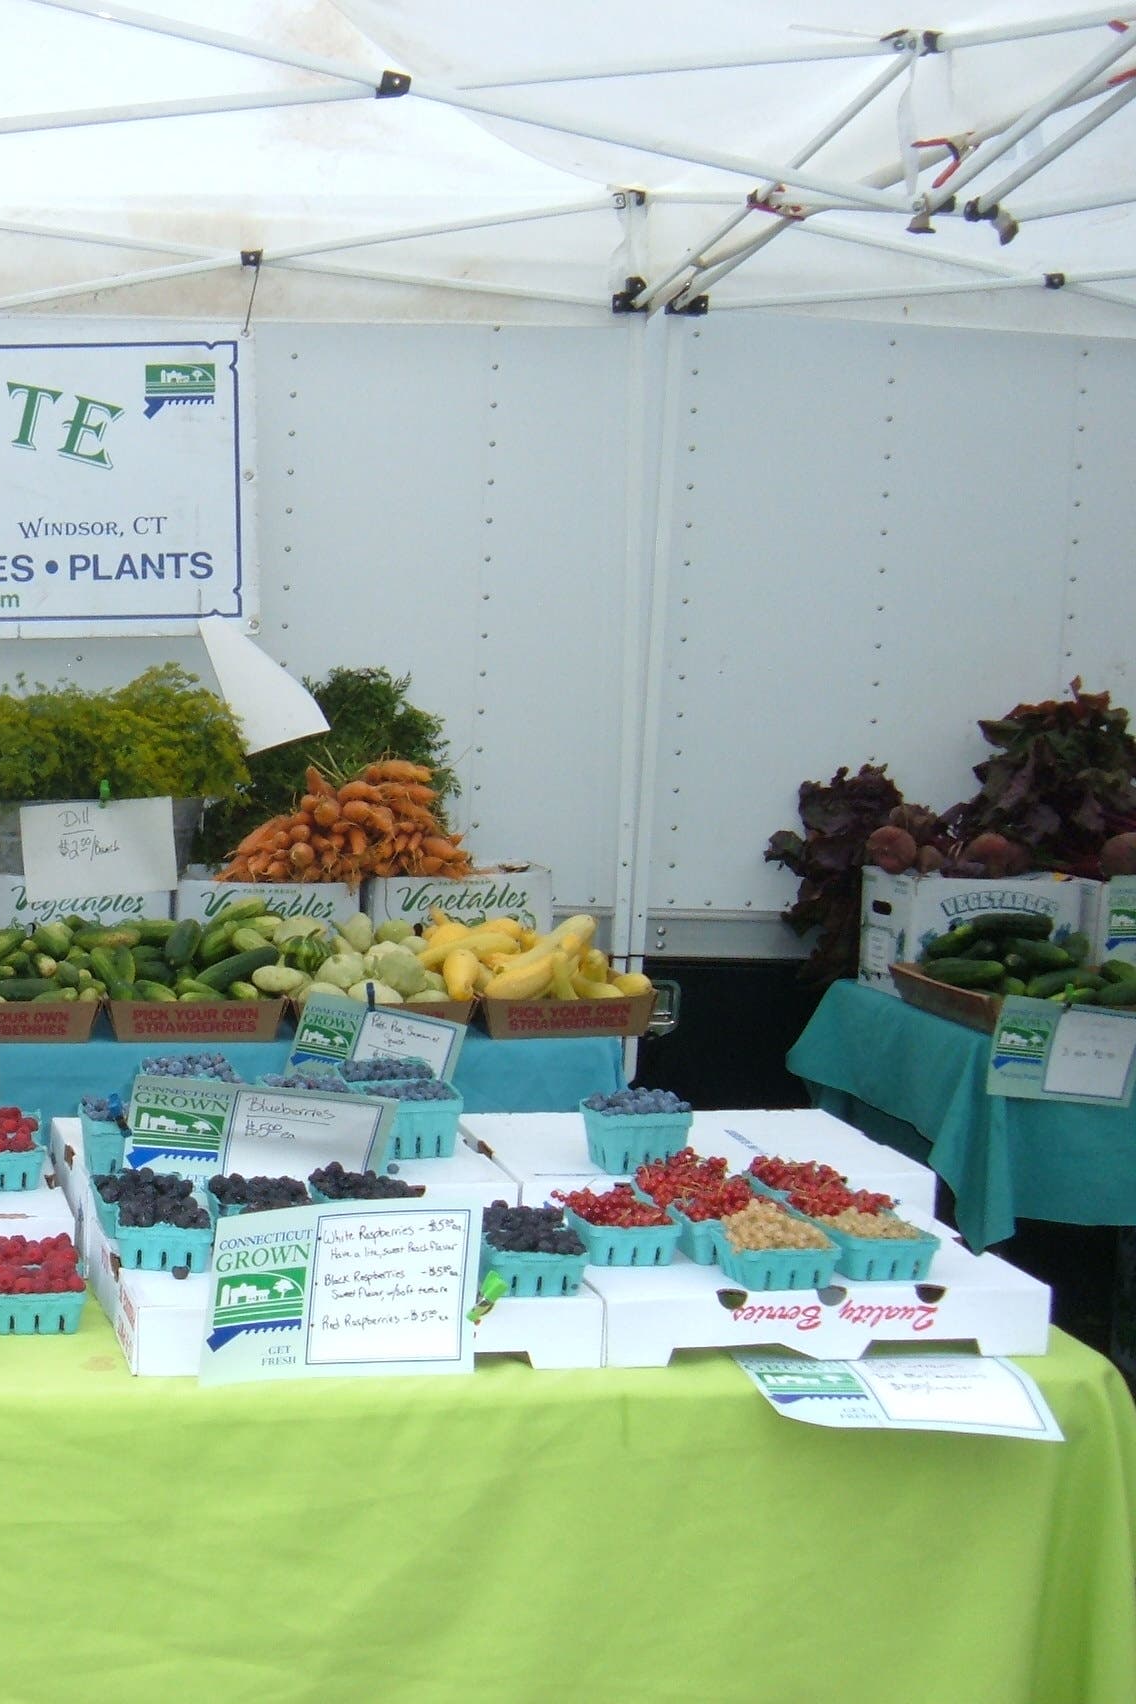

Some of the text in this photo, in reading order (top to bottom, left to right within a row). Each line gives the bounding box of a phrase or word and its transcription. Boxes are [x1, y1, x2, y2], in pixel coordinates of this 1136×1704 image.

[133, 516, 168, 536] CT
[69, 551, 214, 581] PLANTS
[58, 806, 90, 828] Dill
[200, 888, 336, 918] Vtables
[33, 1010, 70, 1023] OWN
[132, 1008, 260, 1022] PICK YOUR OWN
[507, 1003, 632, 1020] PICK YOUR OWN
[134, 1021, 258, 1035] STRAWBERRIES
[303, 1014, 358, 1033] GROWN
[508, 1017, 630, 1032] STRAWBERRIES
[136, 1083, 233, 1101] CONNECTICUT
[133, 1091, 231, 1114] GROWN
[246, 1096, 336, 1120] Blueberries
[218, 1228, 314, 1251] CONNECTICUT
[358, 1225, 415, 1245] Raspberries
[216, 1243, 311, 1274] GROWN
[324, 1273, 350, 1287] Black
[322, 1314, 340, 1331] Red
[733, 1298, 938, 1331] Quality Berries
[268, 1345, 292, 1355] GET
[261, 1355, 297, 1367] FRESH
